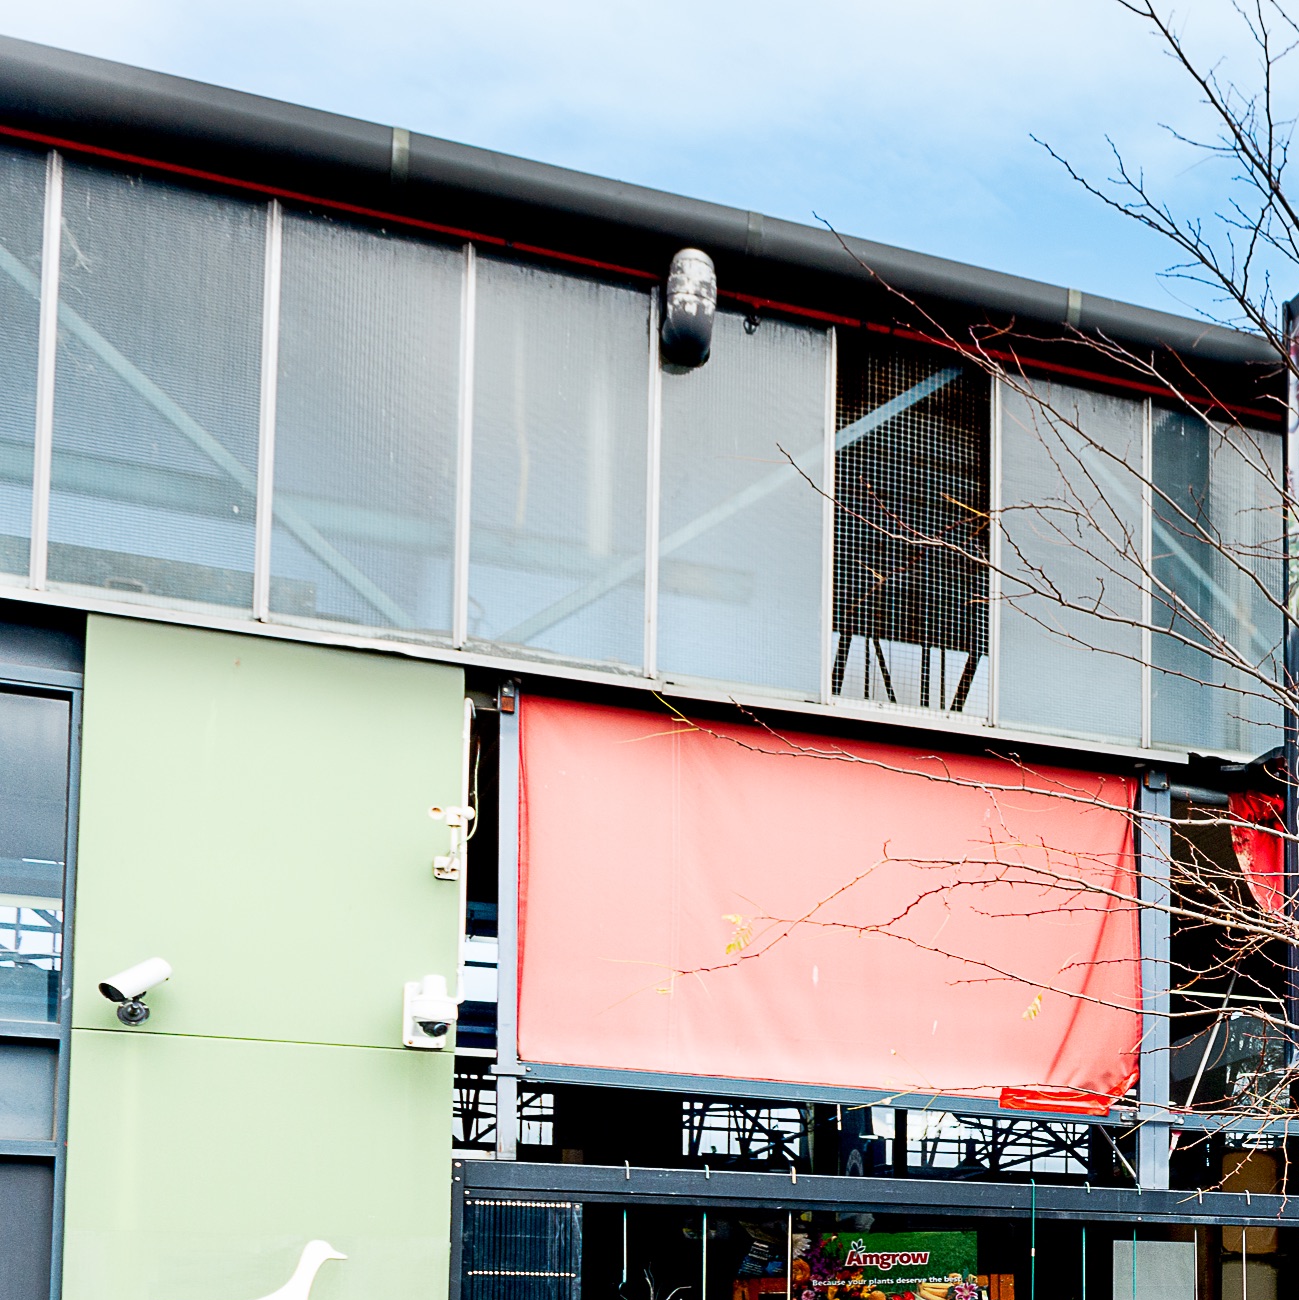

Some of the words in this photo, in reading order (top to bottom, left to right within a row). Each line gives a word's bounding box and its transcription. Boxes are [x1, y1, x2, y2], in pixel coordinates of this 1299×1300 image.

[845, 1249, 930, 1270] Amgrow
[812, 1279, 846, 1287] Because
[848, 1279, 867, 1288] your
[868, 1277, 894, 1287] plants
[896, 1276, 927, 1284] deserve
[928, 1275, 943, 1283] the
